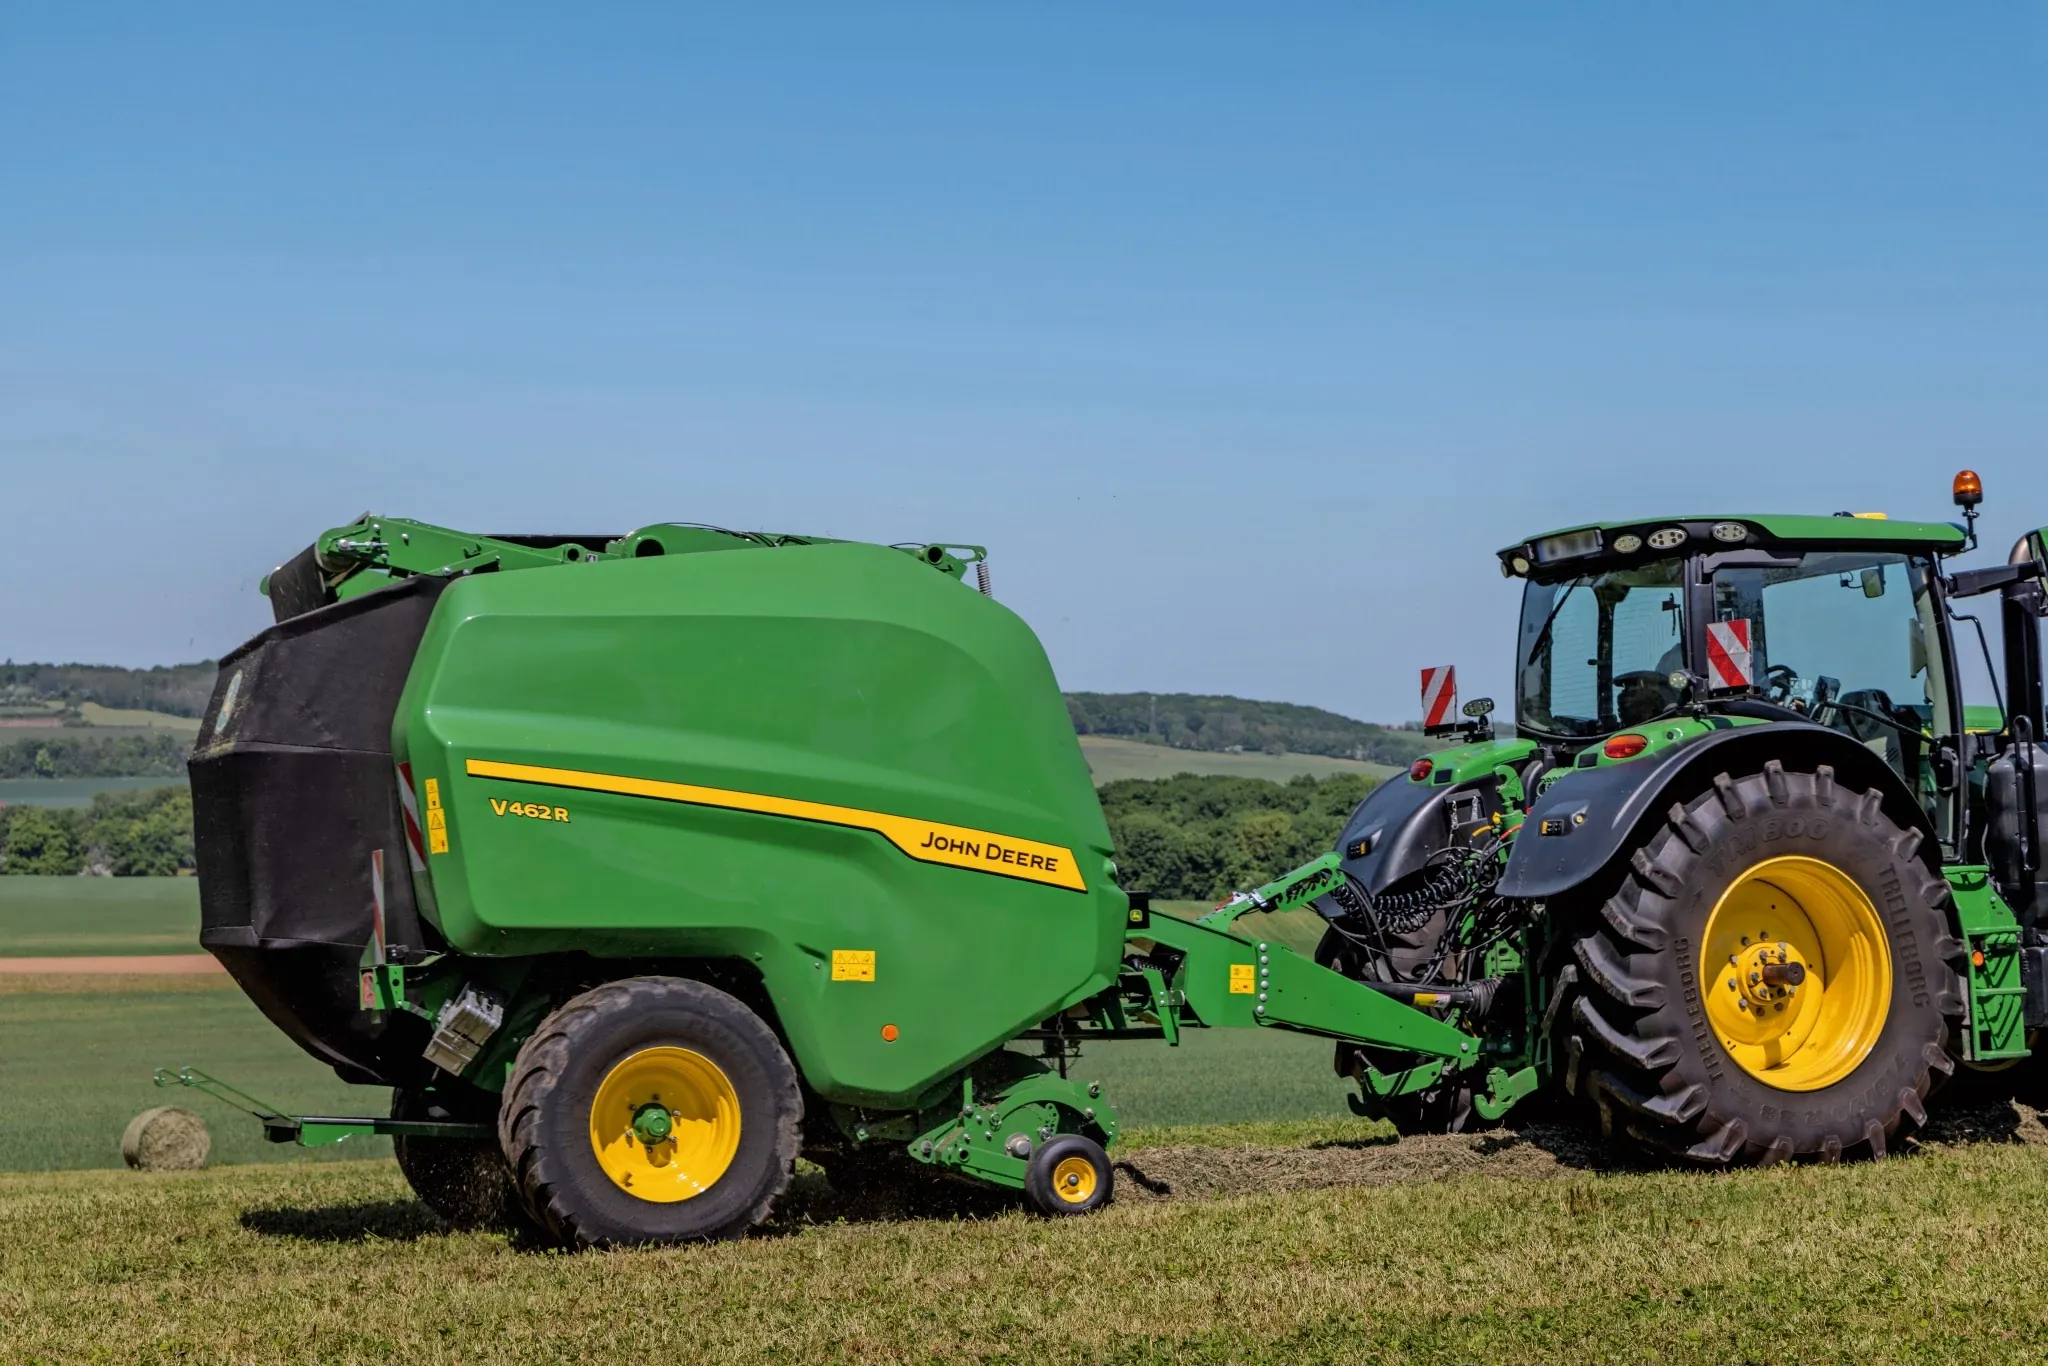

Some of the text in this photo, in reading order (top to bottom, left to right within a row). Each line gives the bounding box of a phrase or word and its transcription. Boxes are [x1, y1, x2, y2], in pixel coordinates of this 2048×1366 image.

[921, 832, 1058, 872] JOHN DEERE
[1877, 862, 1931, 1008] TRELLEBORG
[1674, 937, 1725, 1087] TRELLEBORG
